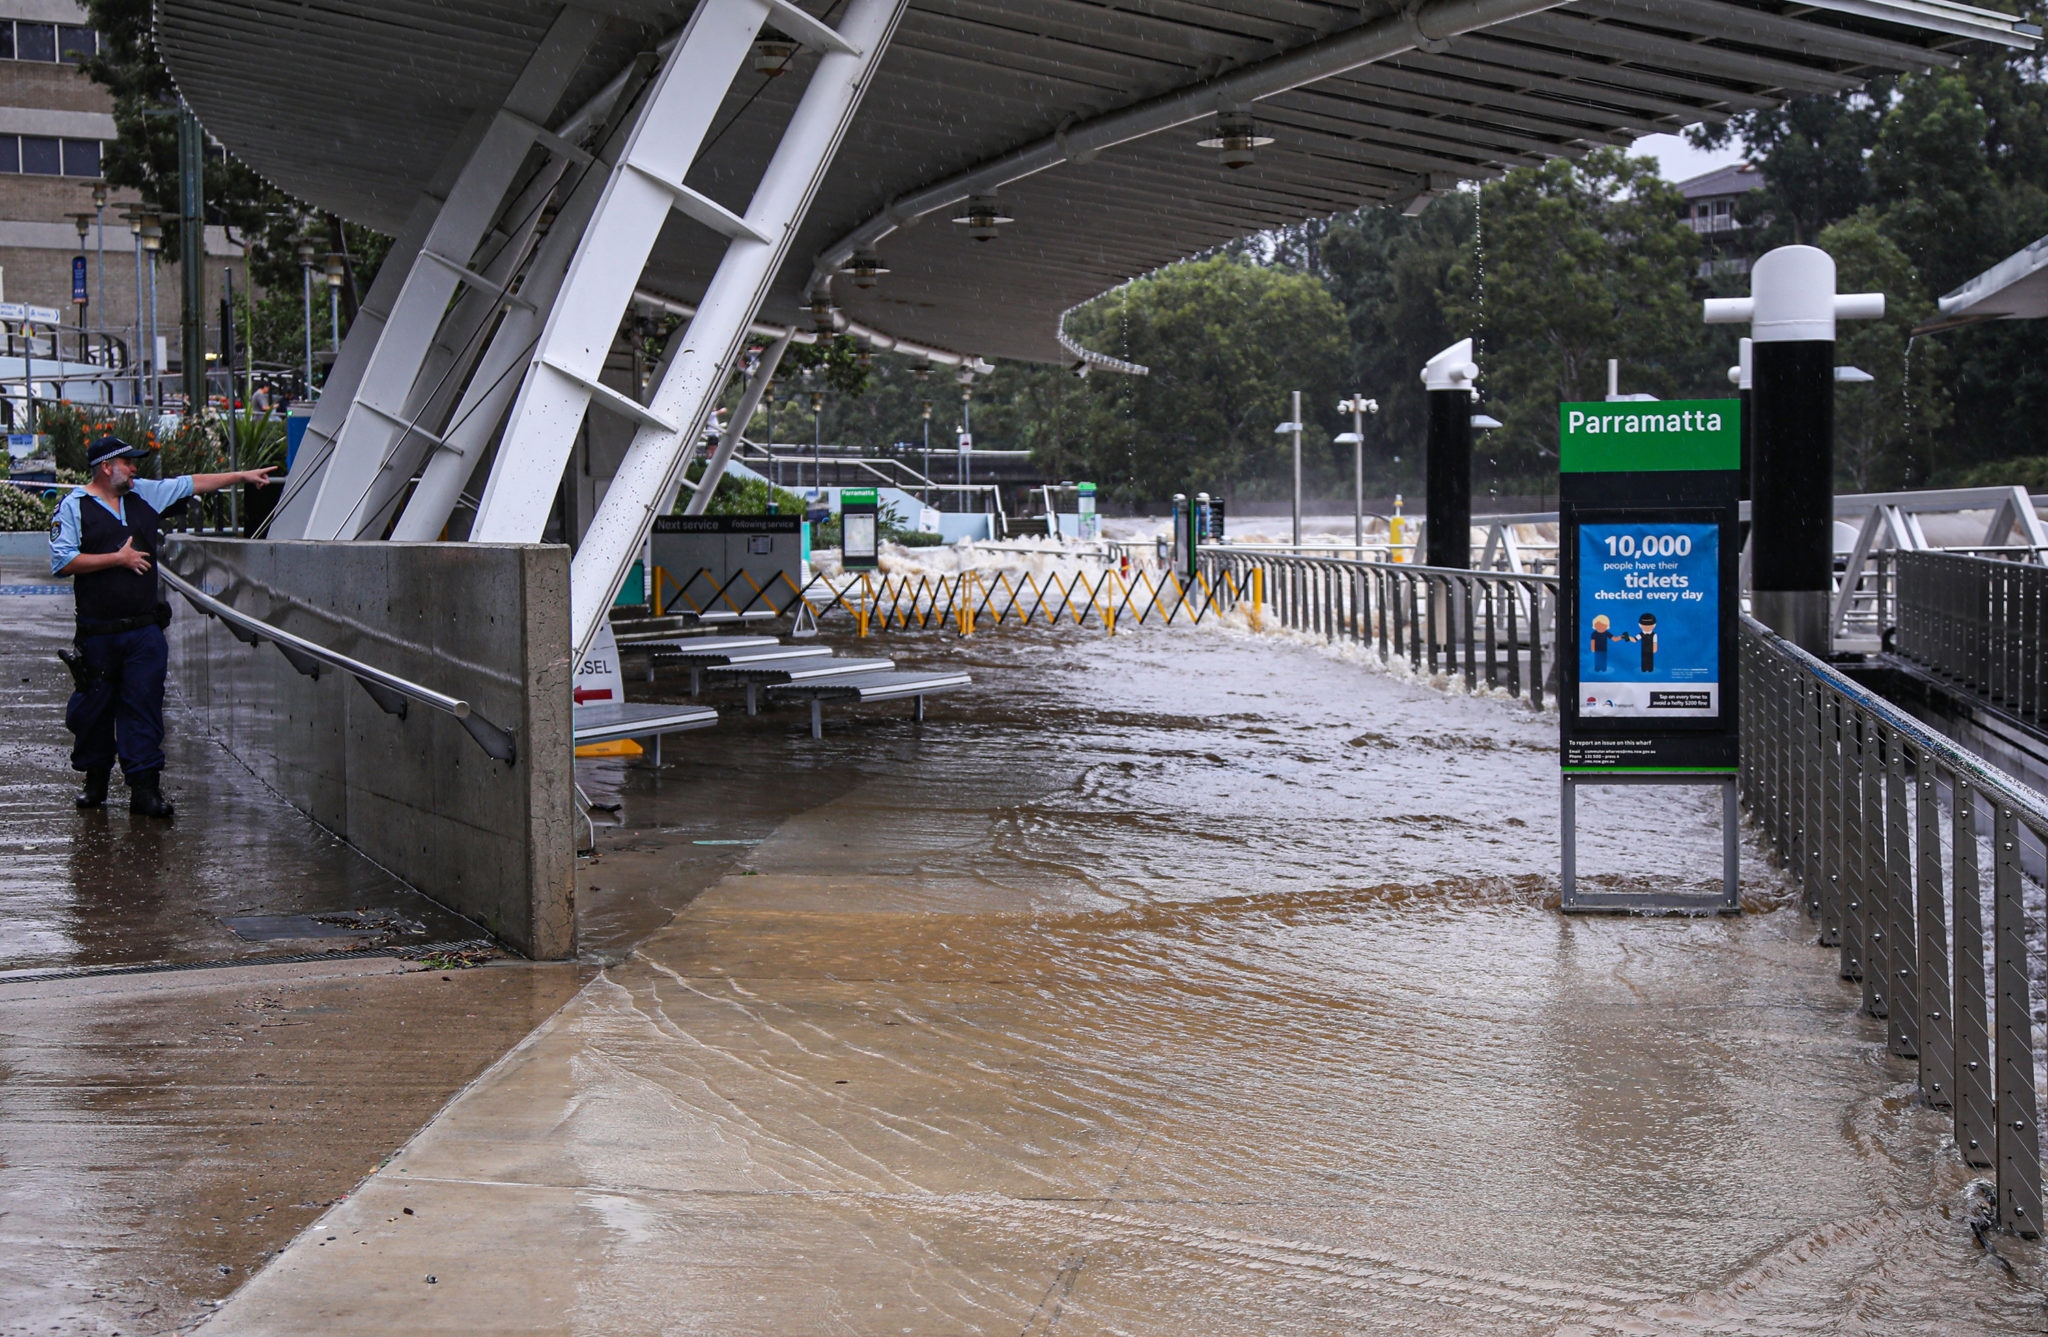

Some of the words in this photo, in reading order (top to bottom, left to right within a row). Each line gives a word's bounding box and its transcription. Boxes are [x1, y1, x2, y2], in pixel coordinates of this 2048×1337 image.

[1568, 410, 1722, 434] Parramatta
[657, 520, 681, 530] Next
[682, 520, 719, 530] service
[731, 520, 767, 530] Following
[767, 520, 794, 529] service
[1604, 535, 1692, 559] 10,000
[1603, 561, 1633, 571] people
[1635, 561, 1656, 570] have
[1658, 560, 1679, 570] their
[1624, 572, 1689, 588] tickets
[1594, 590, 1643, 600] checked
[1646, 591, 1679, 602] every
[1681, 590, 1704, 602] day
